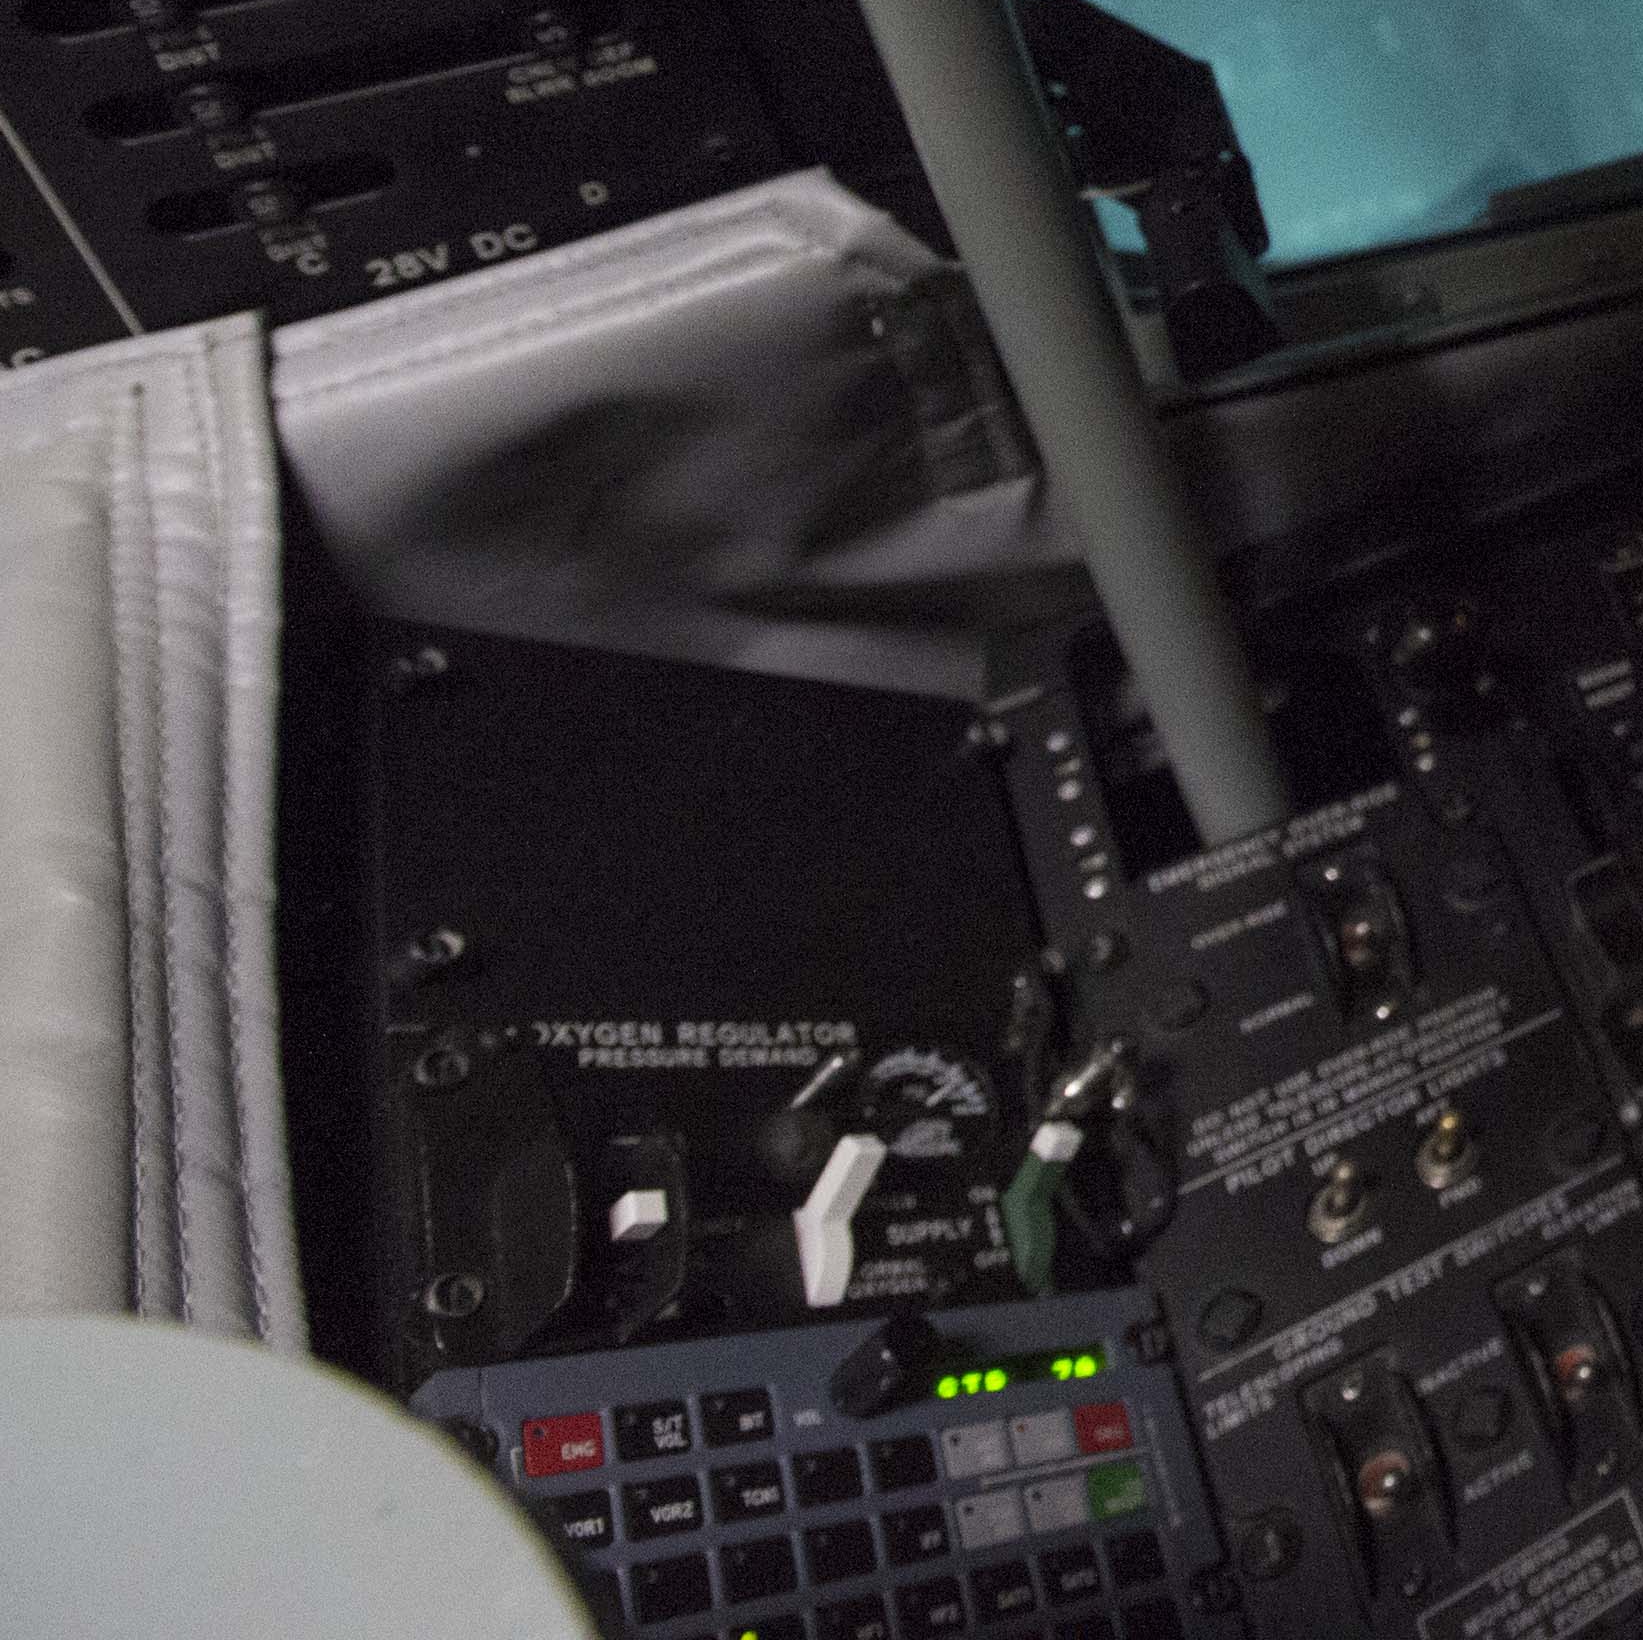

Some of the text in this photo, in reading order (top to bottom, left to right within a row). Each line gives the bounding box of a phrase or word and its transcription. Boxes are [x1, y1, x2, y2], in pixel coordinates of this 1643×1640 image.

[364, 222, 540, 288] 28V DC
[676, 1019, 858, 1048] REGULATOR
[649, 1499, 697, 1524] VOR2
[563, 1516, 606, 1539] VOR1
